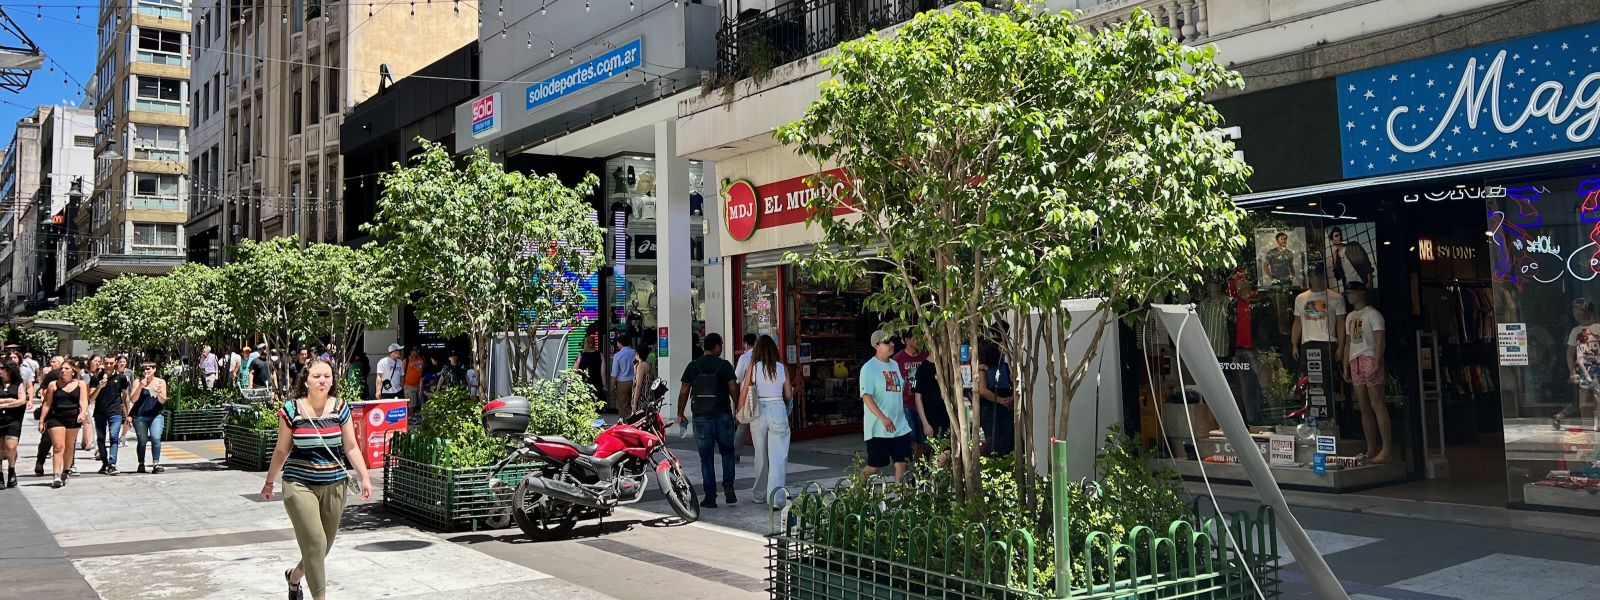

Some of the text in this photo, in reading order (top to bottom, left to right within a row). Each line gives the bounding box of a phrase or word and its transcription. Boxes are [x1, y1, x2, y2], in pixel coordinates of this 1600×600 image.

[529, 46, 637, 104] solodeportes.com.ar
[472, 98, 494, 122] solo
[728, 202, 753, 220] MDJ
[764, 195, 783, 214] EL
[1219, 362, 1250, 371] STONE
